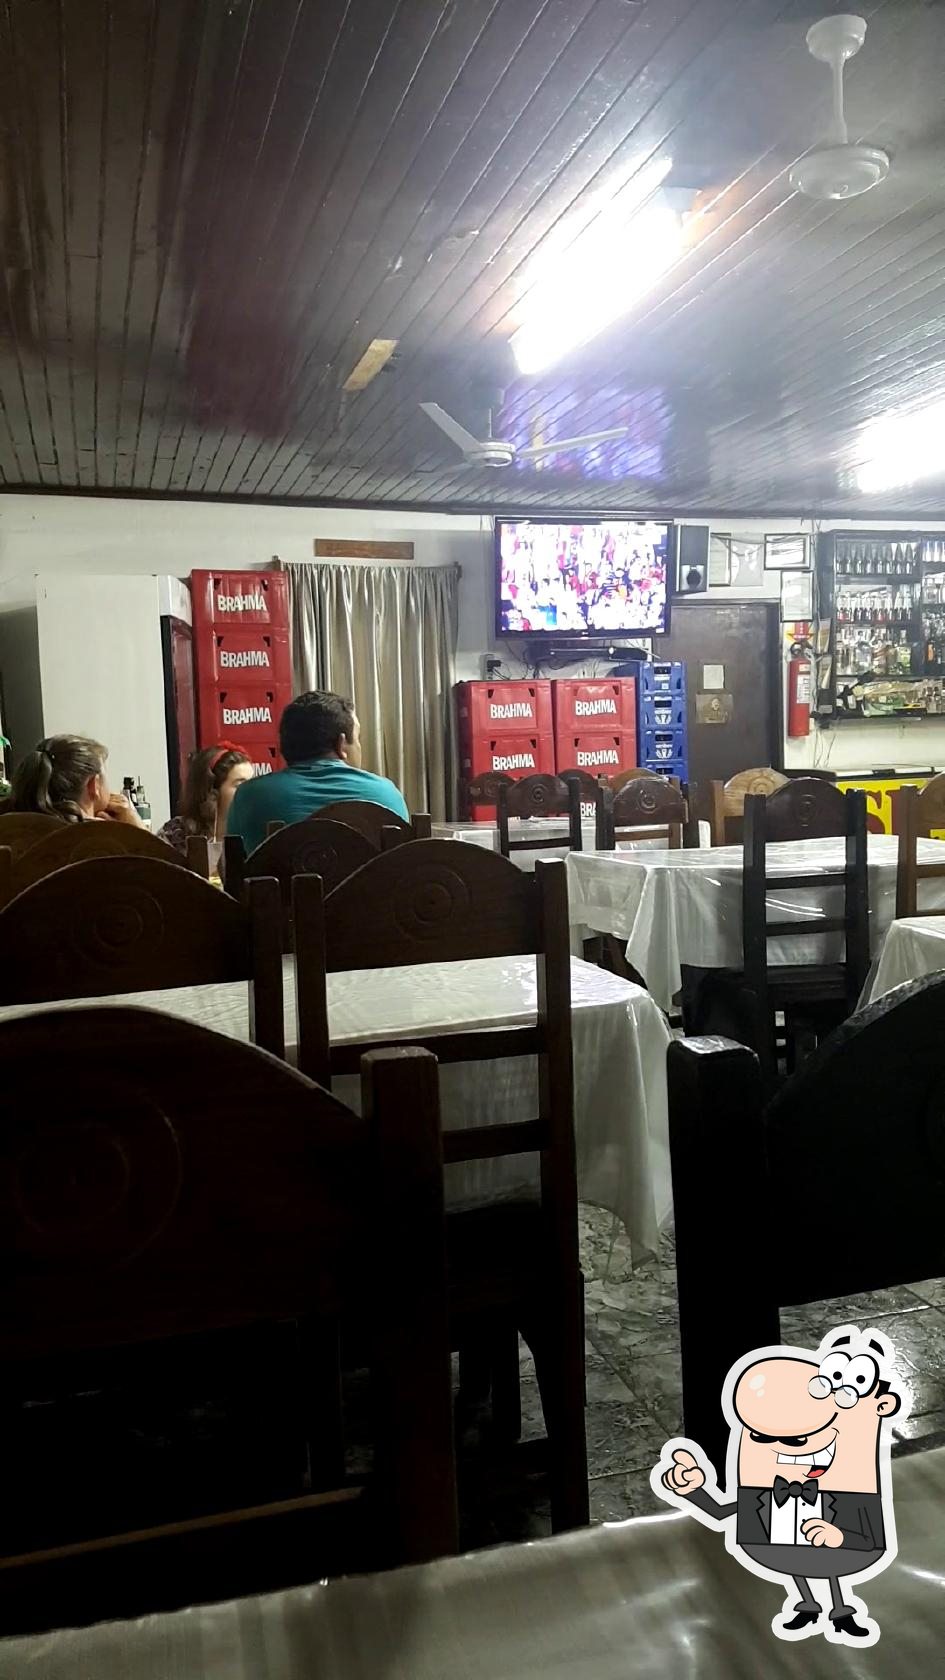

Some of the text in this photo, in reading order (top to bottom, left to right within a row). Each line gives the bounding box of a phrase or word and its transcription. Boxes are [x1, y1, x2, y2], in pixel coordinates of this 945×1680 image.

[217, 594, 267, 612] BRAHMA
[220, 650, 270, 668] BRAHMA
[223, 707, 272, 725] BRAHMA
[490, 703, 533, 719] BRAHMA
[575, 699, 617, 716] BRAHMA
[492, 753, 535, 771] BRAHMA
[577, 750, 619, 767] BRAHMA
